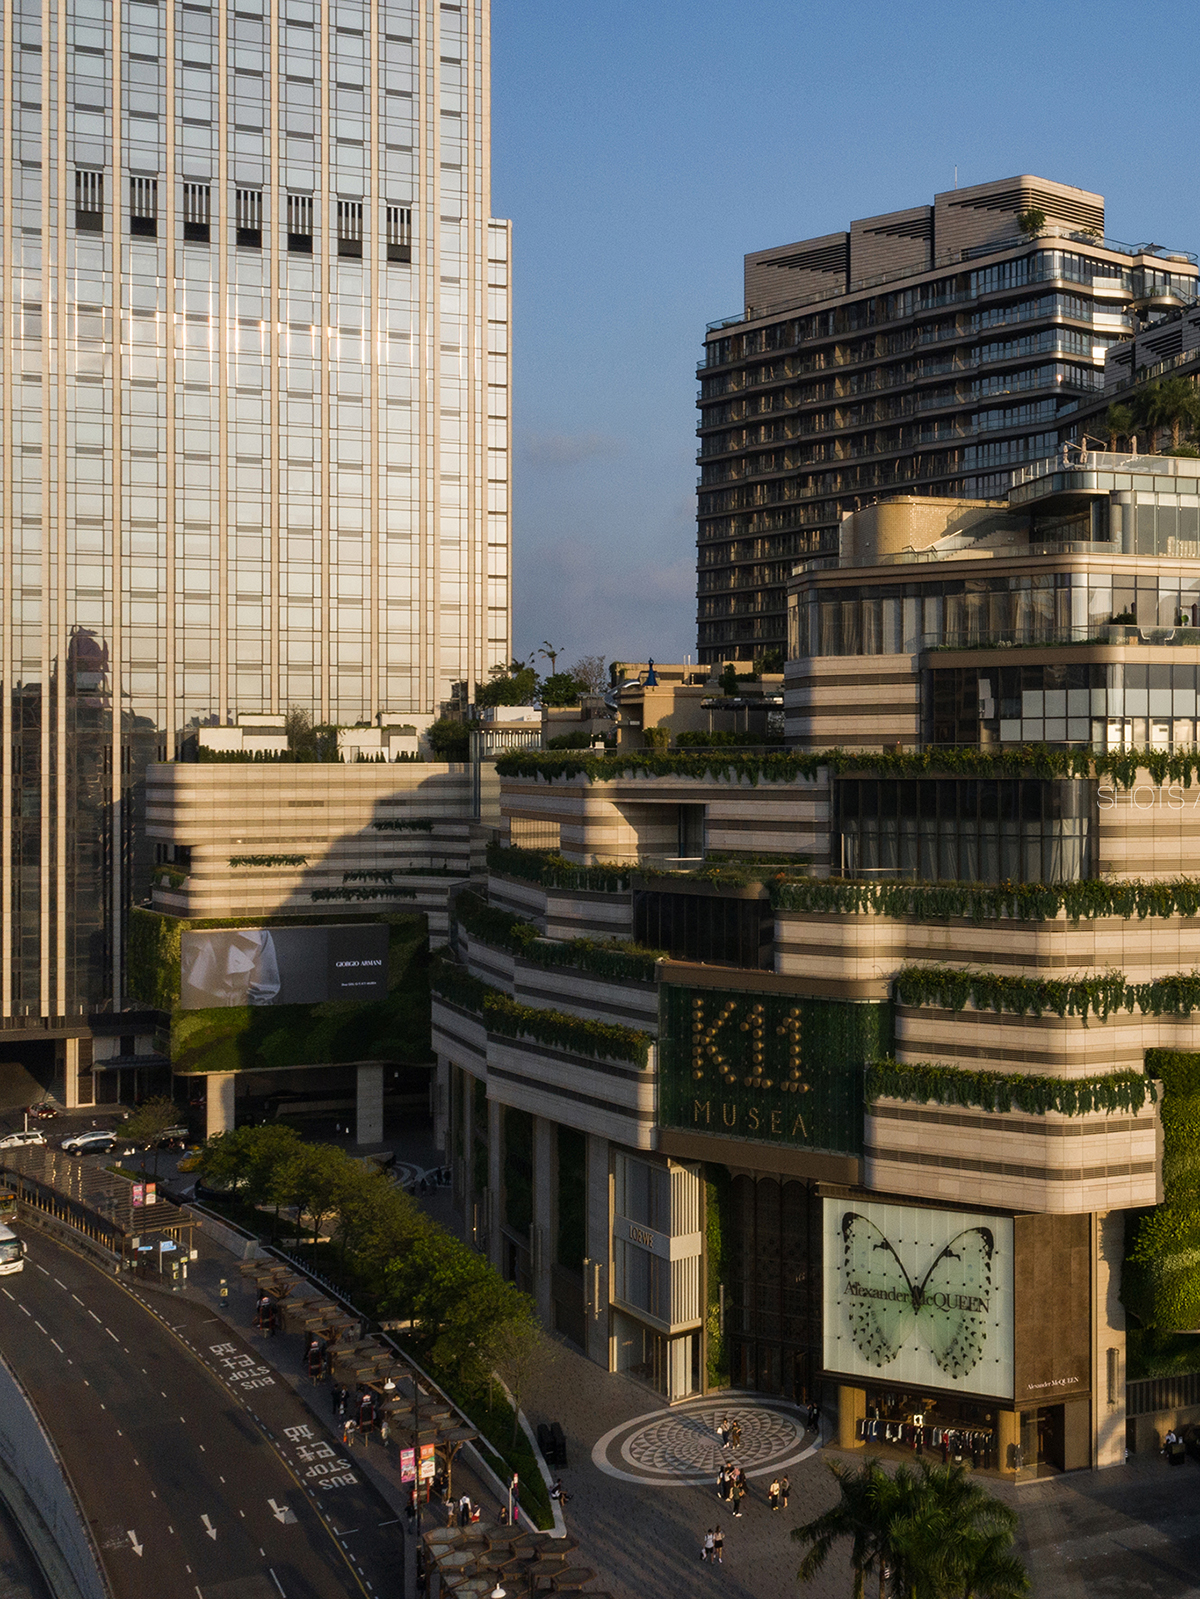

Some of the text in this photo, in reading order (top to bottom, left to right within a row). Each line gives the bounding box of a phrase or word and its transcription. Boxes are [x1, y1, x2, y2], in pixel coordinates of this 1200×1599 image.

[692, 998, 811, 1094] K11
[694, 1099, 808, 1138] MUSEA
[629, 1225, 654, 1249] LOEWE
[843, 1281, 910, 1303] Alexander
[209, 1342, 237, 1356] 站
[220, 1354, 256, 1369] 巴士
[229, 1366, 270, 1381] STOP
[240, 1376, 276, 1390] BUS
[283, 1424, 314, 1442] 站
[305, 1459, 351, 1477] STOP
[318, 1473, 358, 1490] BUS
